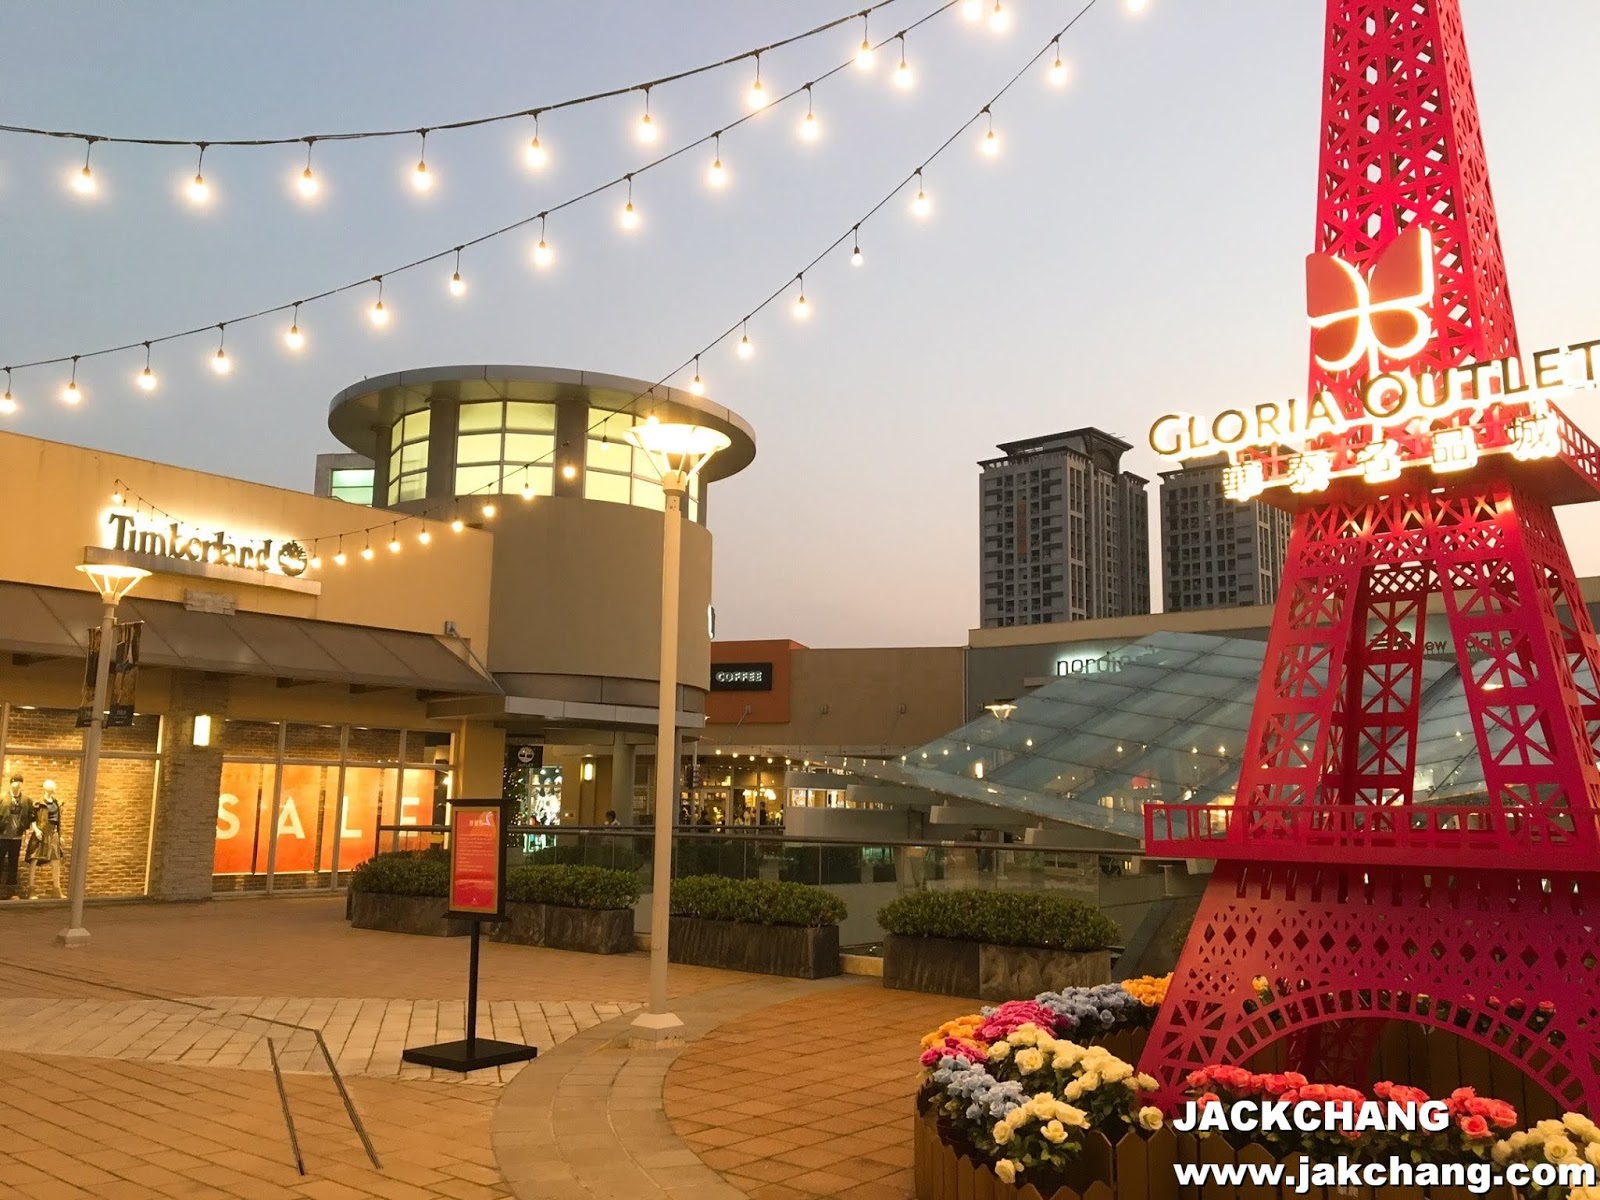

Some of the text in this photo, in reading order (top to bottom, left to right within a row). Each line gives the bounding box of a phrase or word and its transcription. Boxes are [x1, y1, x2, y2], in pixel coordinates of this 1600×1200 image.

[1149, 339, 1600, 455] GLORIA OUTLET
[108, 513, 273, 572] Timberland
[715, 670, 763, 683] COFFEE
[215, 793, 421, 840] SALE
